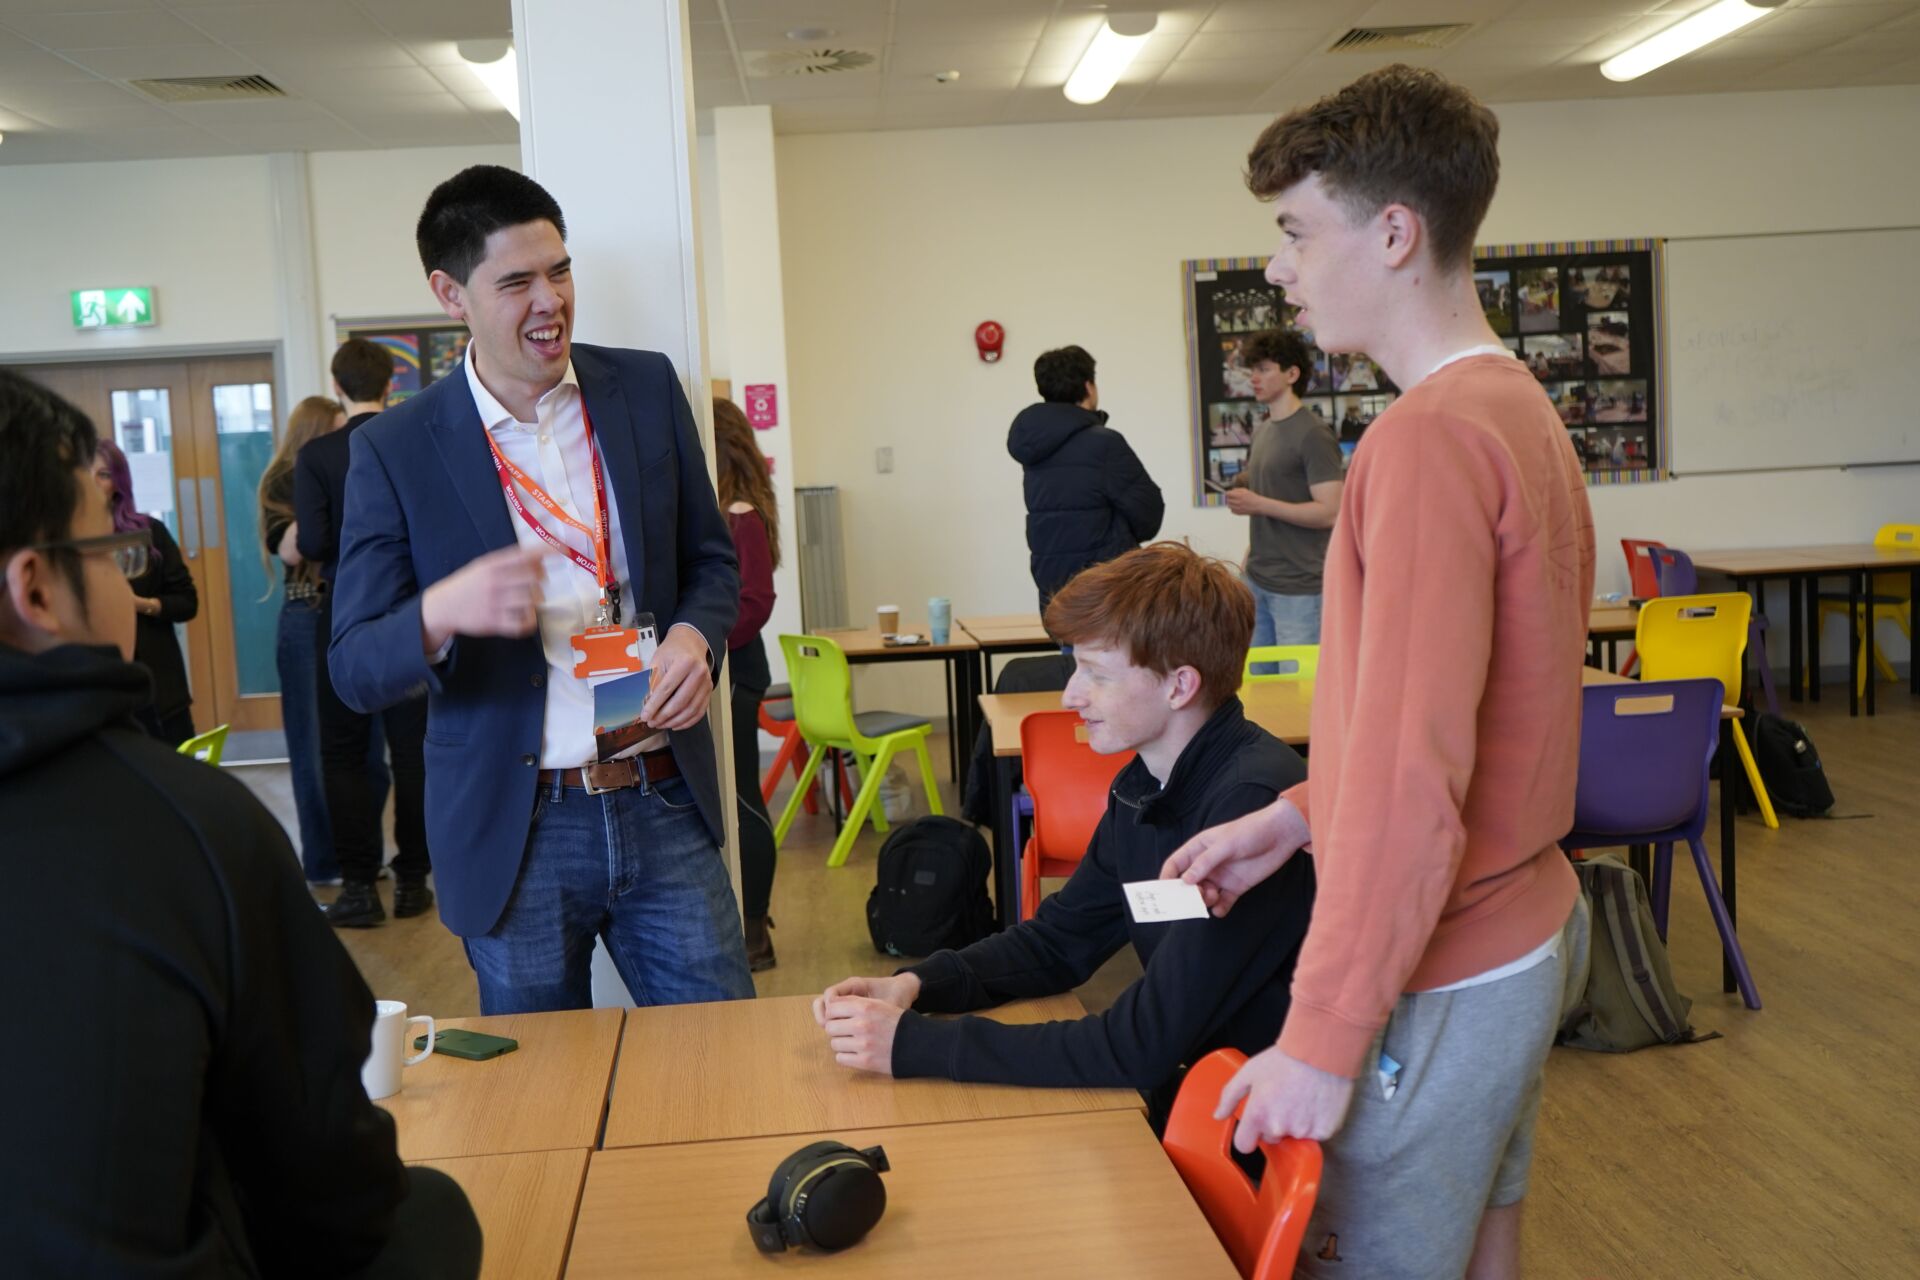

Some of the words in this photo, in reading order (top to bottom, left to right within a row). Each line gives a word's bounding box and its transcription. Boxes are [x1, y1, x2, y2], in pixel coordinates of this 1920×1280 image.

[488, 442, 502, 471] VISIT
[505, 484, 523, 513] VISITOR
[532, 488, 554, 509] STAFF
[535, 525, 561, 549] VISITOR
[601, 509, 609, 539] VISITOR
[575, 555, 598, 574] SITOR
